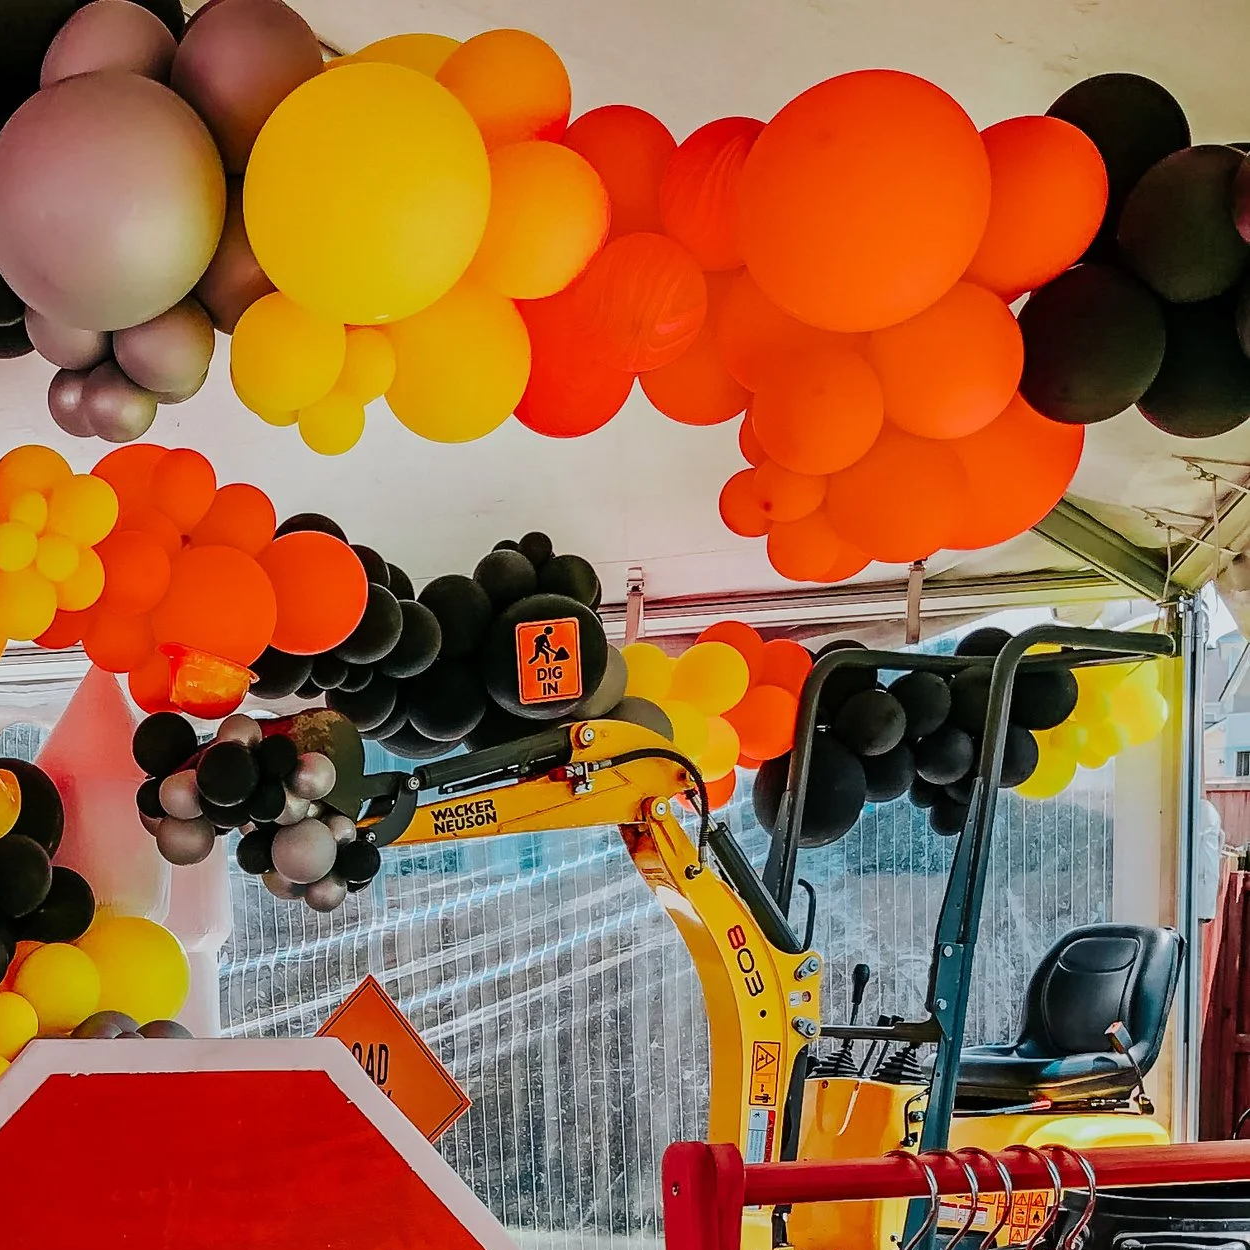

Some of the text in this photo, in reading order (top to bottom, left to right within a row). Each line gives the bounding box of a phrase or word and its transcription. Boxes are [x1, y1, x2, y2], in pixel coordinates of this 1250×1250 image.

[536, 666, 563, 681] DIG
[542, 681, 559, 695] IN
[431, 799, 496, 822] WACKER
[434, 811, 498, 836] NEUSON
[727, 924, 765, 997] 803
